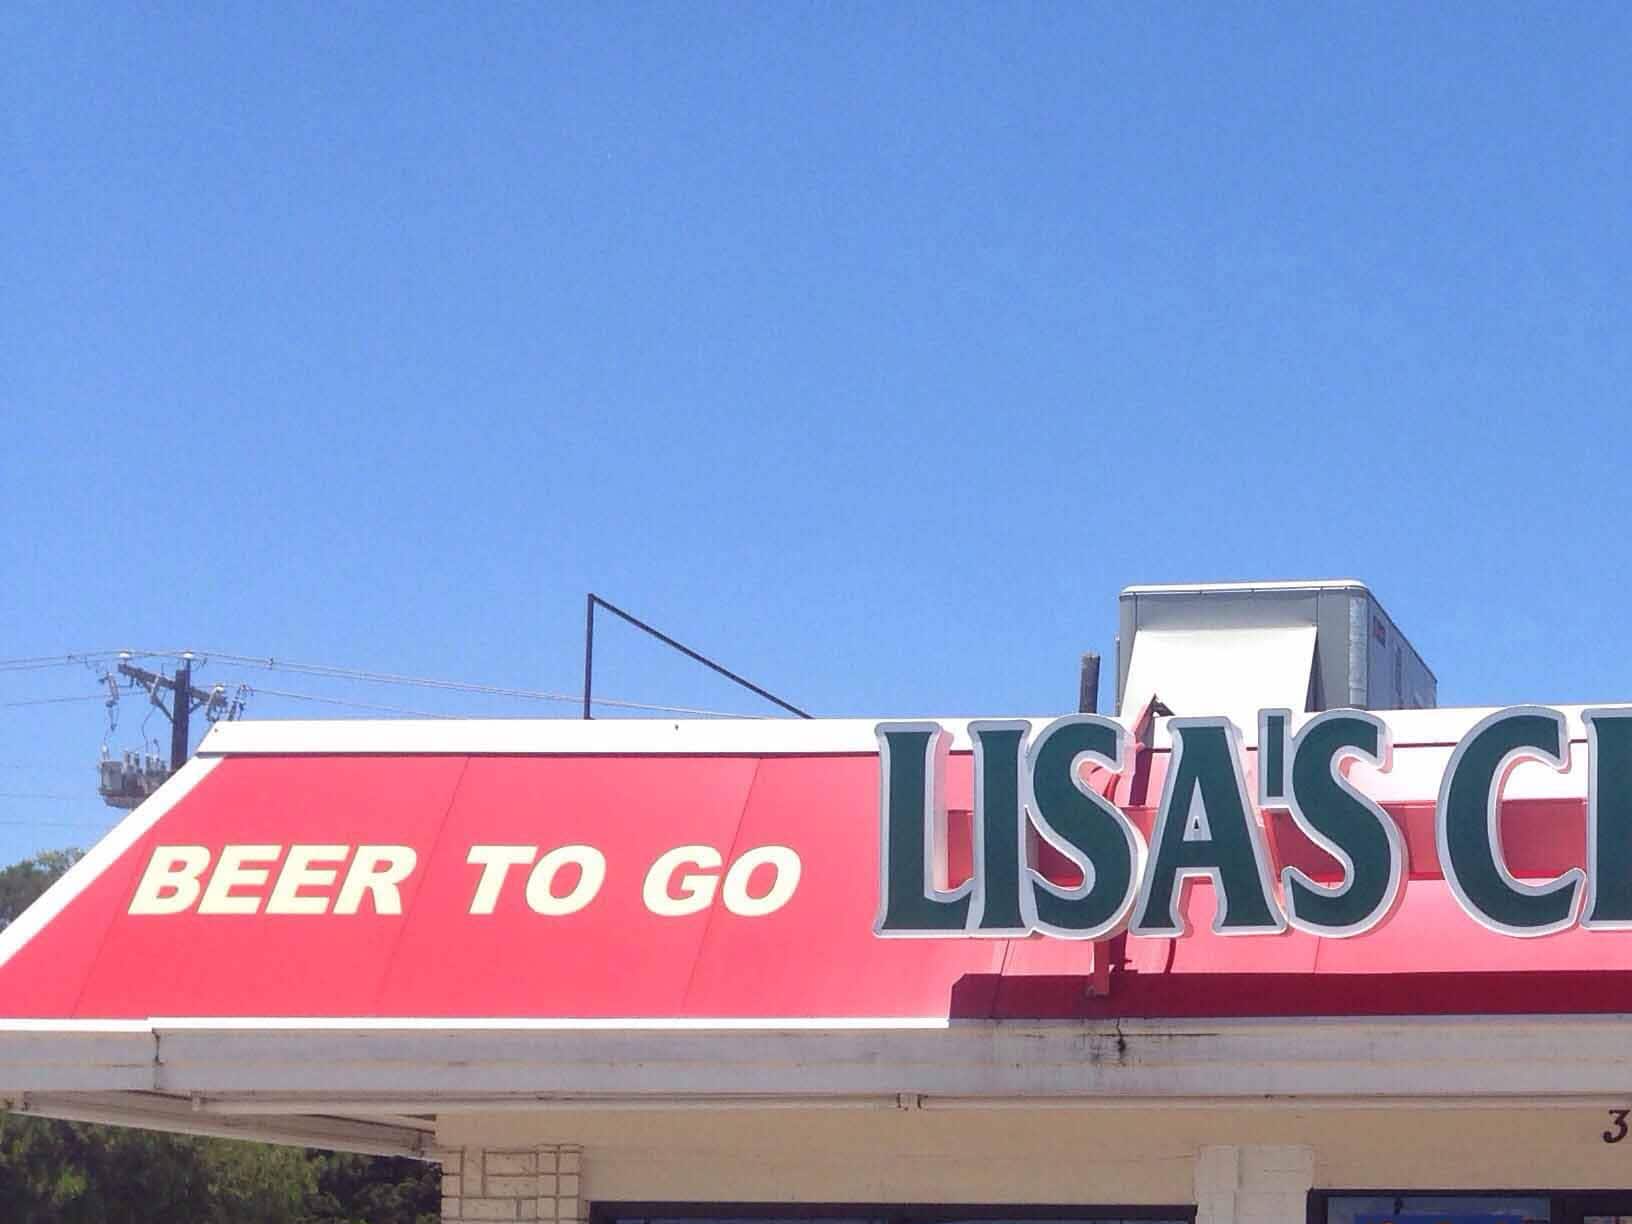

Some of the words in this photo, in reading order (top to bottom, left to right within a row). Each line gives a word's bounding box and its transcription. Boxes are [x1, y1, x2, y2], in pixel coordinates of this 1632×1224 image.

[128, 844, 418, 917] BEER
[466, 844, 606, 917] TO
[642, 844, 802, 917] GO
[874, 708, 1408, 942] LISA'S
